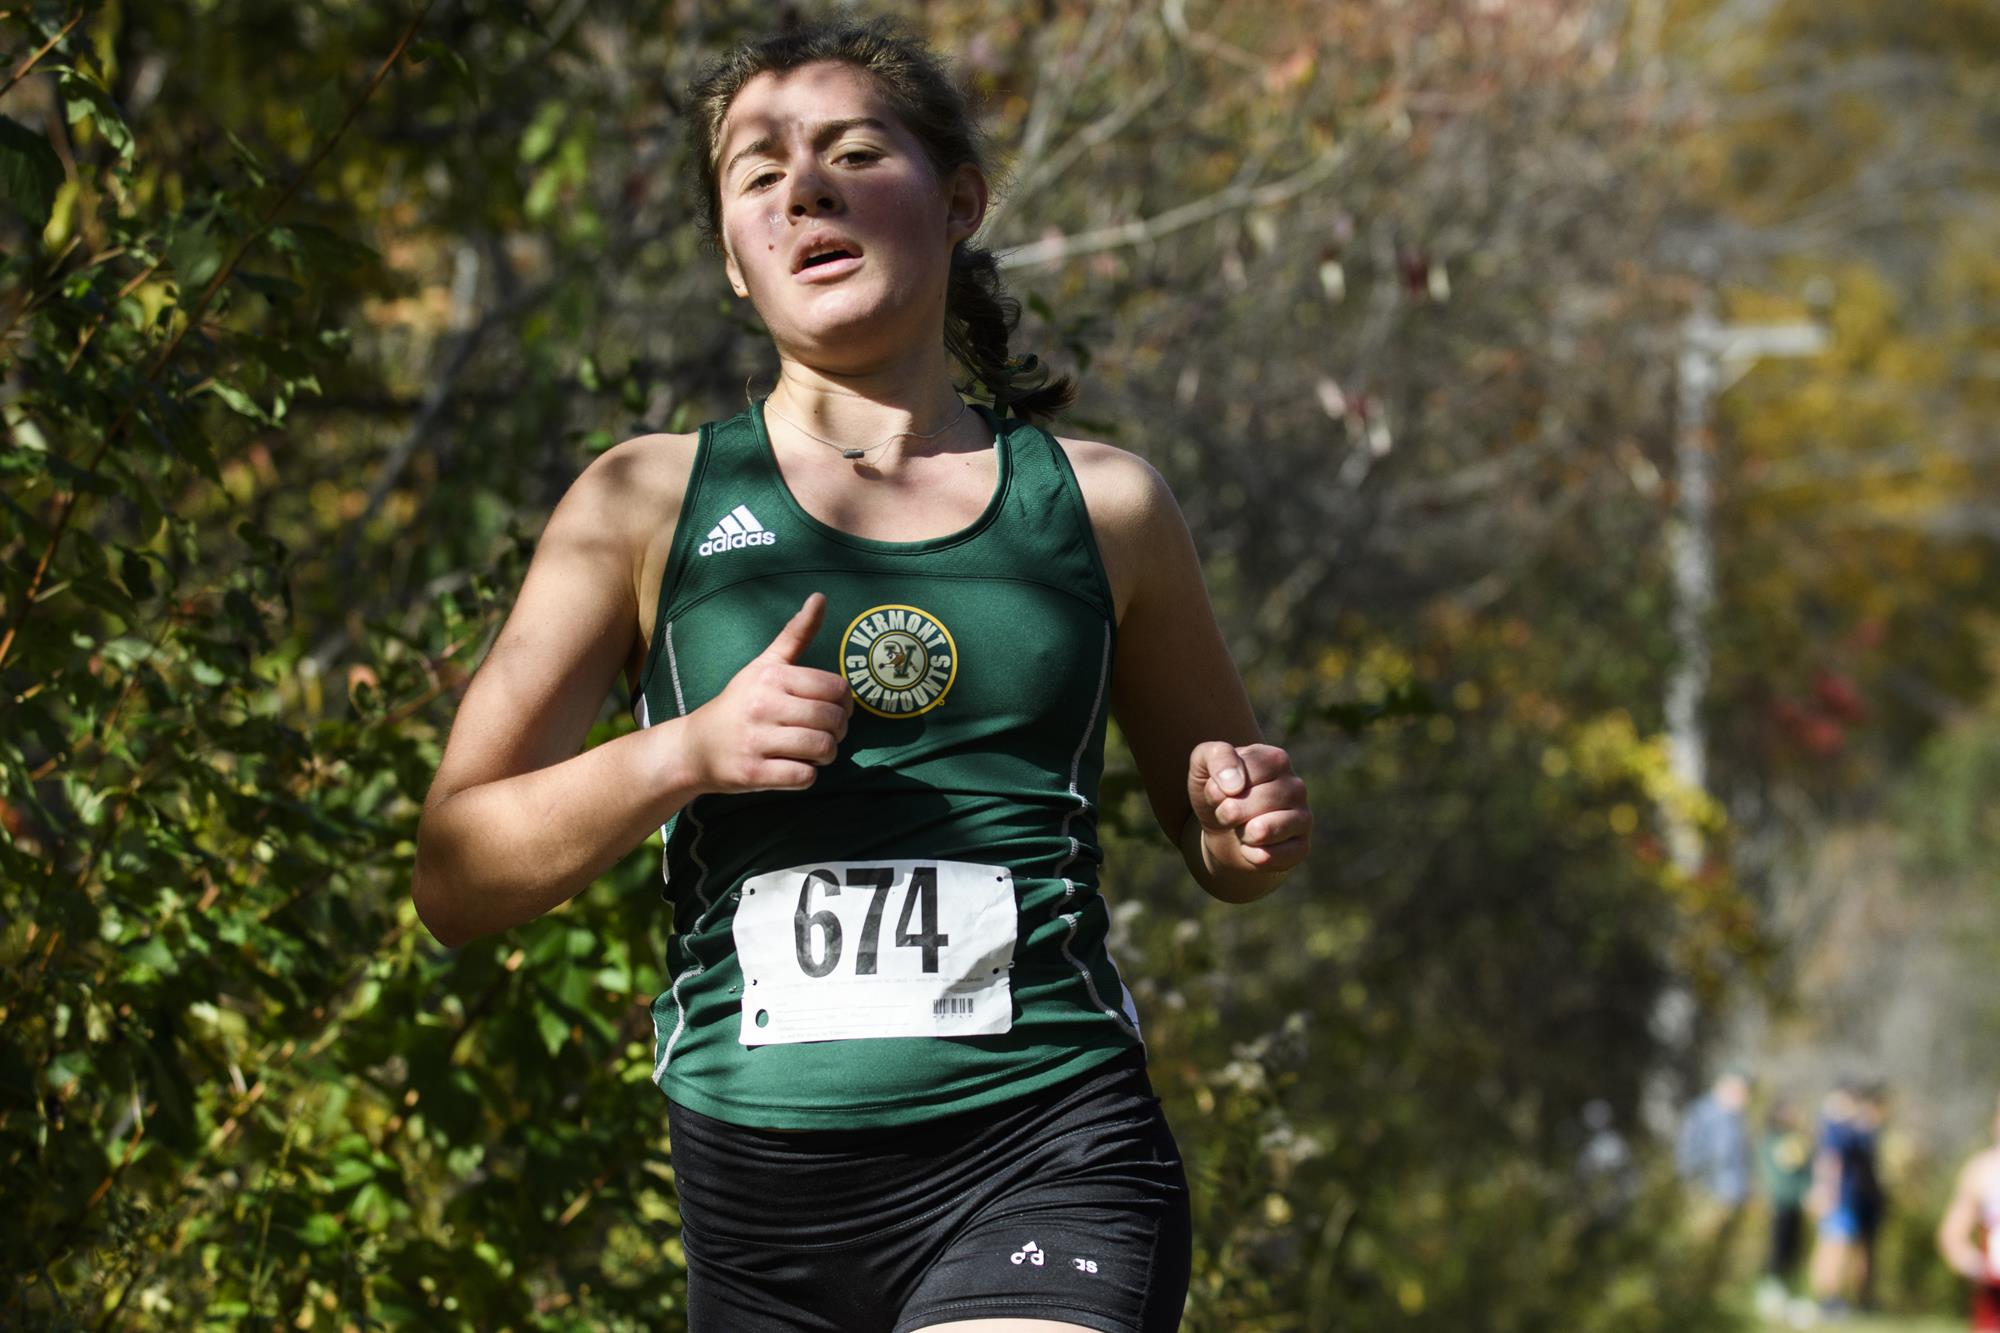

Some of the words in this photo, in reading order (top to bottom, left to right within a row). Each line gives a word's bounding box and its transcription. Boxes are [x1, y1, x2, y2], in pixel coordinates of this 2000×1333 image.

[698, 530, 776, 557] adidas
[849, 610, 947, 649] VERMONT
[846, 655, 951, 713] CATAMOUNTS
[794, 866, 949, 978] 674
